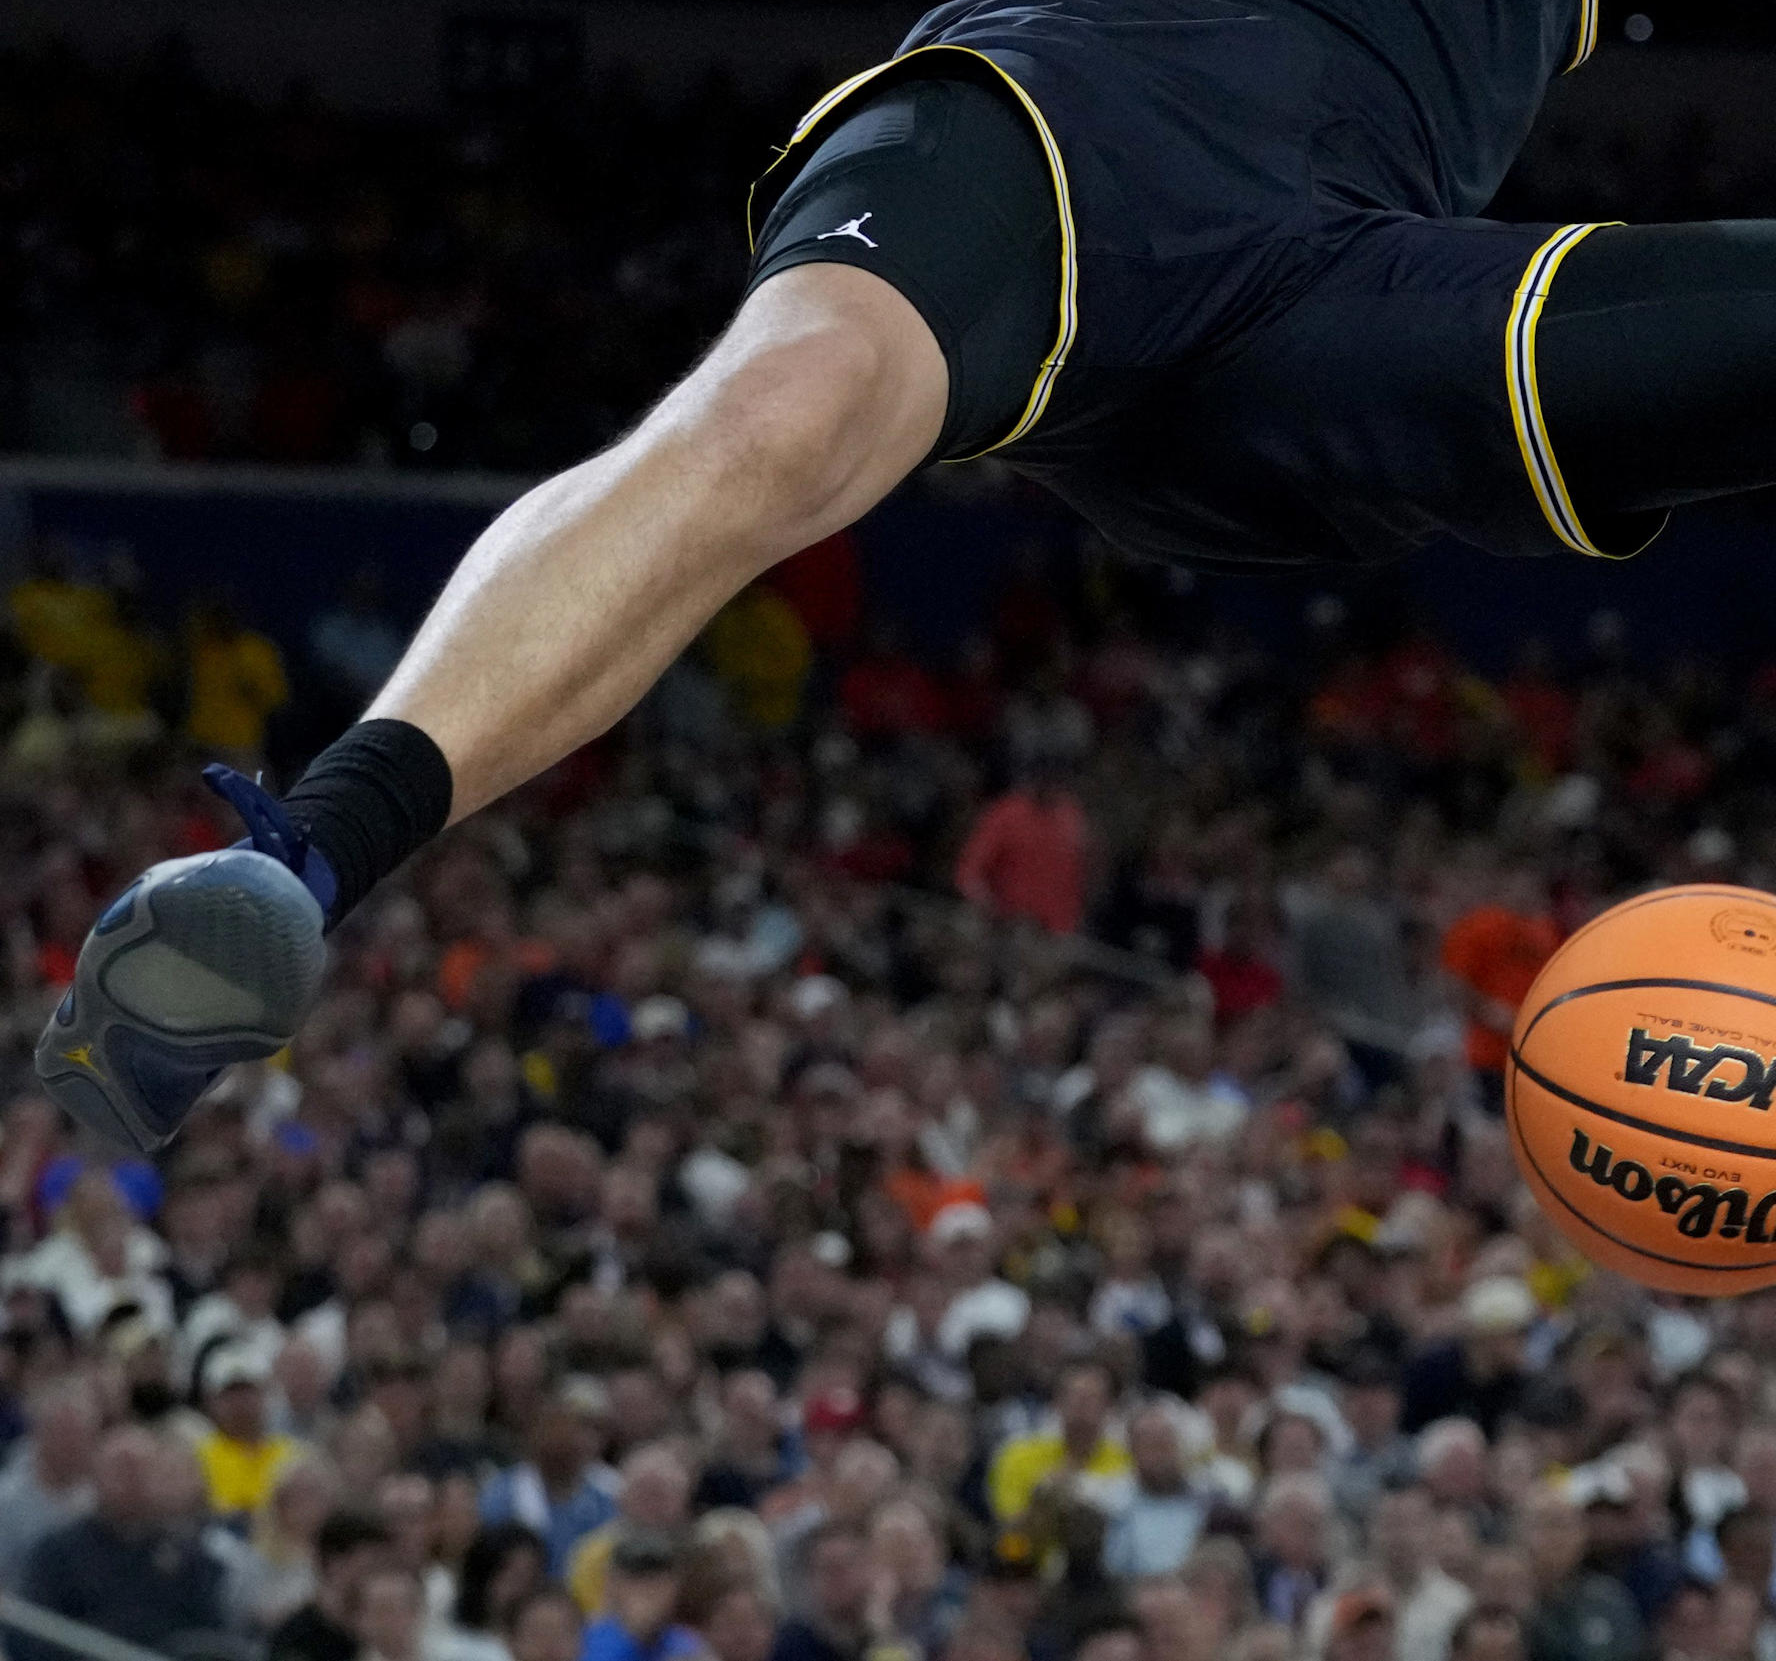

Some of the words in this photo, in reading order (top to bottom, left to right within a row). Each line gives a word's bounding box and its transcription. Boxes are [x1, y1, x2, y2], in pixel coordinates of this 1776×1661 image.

[1636, 1012, 1683, 1029] BALL
[1689, 1022, 1743, 1041] GAME
[1658, 1156, 1698, 1175] NXT
[1702, 1167, 1742, 1183] EVO
